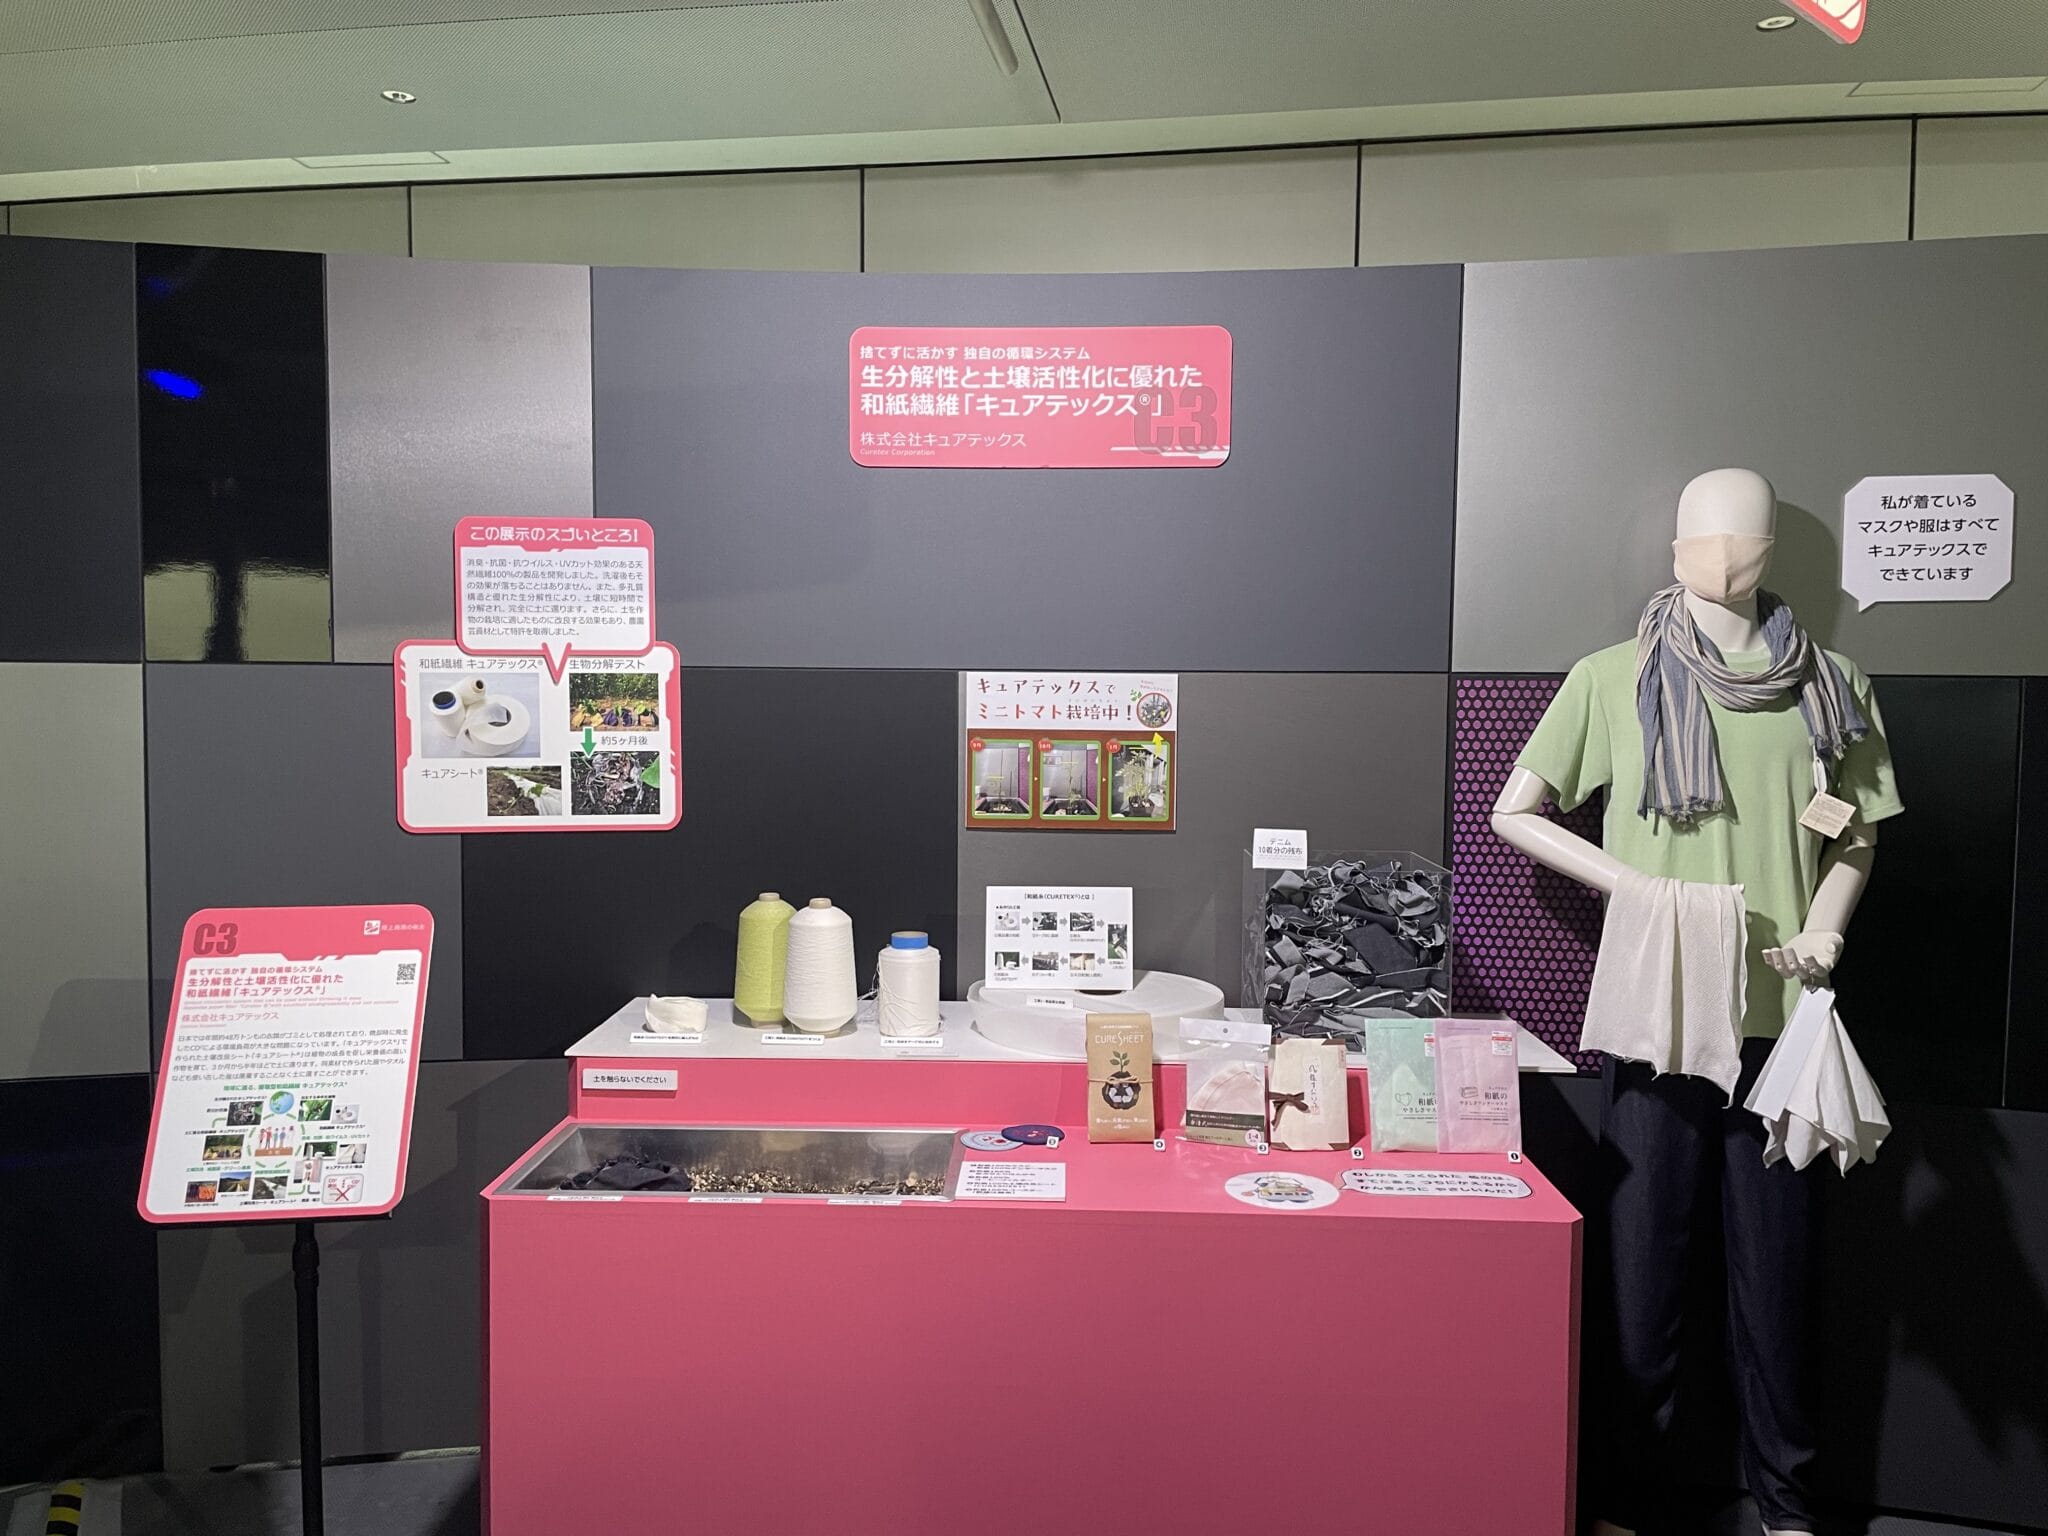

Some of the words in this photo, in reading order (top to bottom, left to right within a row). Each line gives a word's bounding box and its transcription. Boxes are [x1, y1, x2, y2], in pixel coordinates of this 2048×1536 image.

[860, 345, 957, 361] 捨てずに活かす
[963, 345, 1090, 361] 独自の循環システム
[861, 364, 1203, 389] 生分解性と土壌活性化に優れた
[860, 392, 1163, 417] 和紙繊維「キュアテックス®」
[1133, 384, 1219, 456] C3
[860, 431, 1027, 448] 株式会社キュアテックス
[891, 448, 935, 457] Corporation
[1881, 494, 1977, 510] 私が着ている
[1858, 518, 2000, 534] マスクや服はすべて
[1868, 542, 1988, 558] キュアテックスで
[1880, 567, 1974, 582] できています
[419, 659, 463, 670] 和紙繊維
[568, 659, 646, 670] 生物分解テスト
[977, 678, 1116, 695] キュアテックスで
[193, 923, 239, 955] C3
[182, 1012, 279, 1022] 株式会社キュアテックス
[593, 1075, 667, 1084] 土を触らないでください
